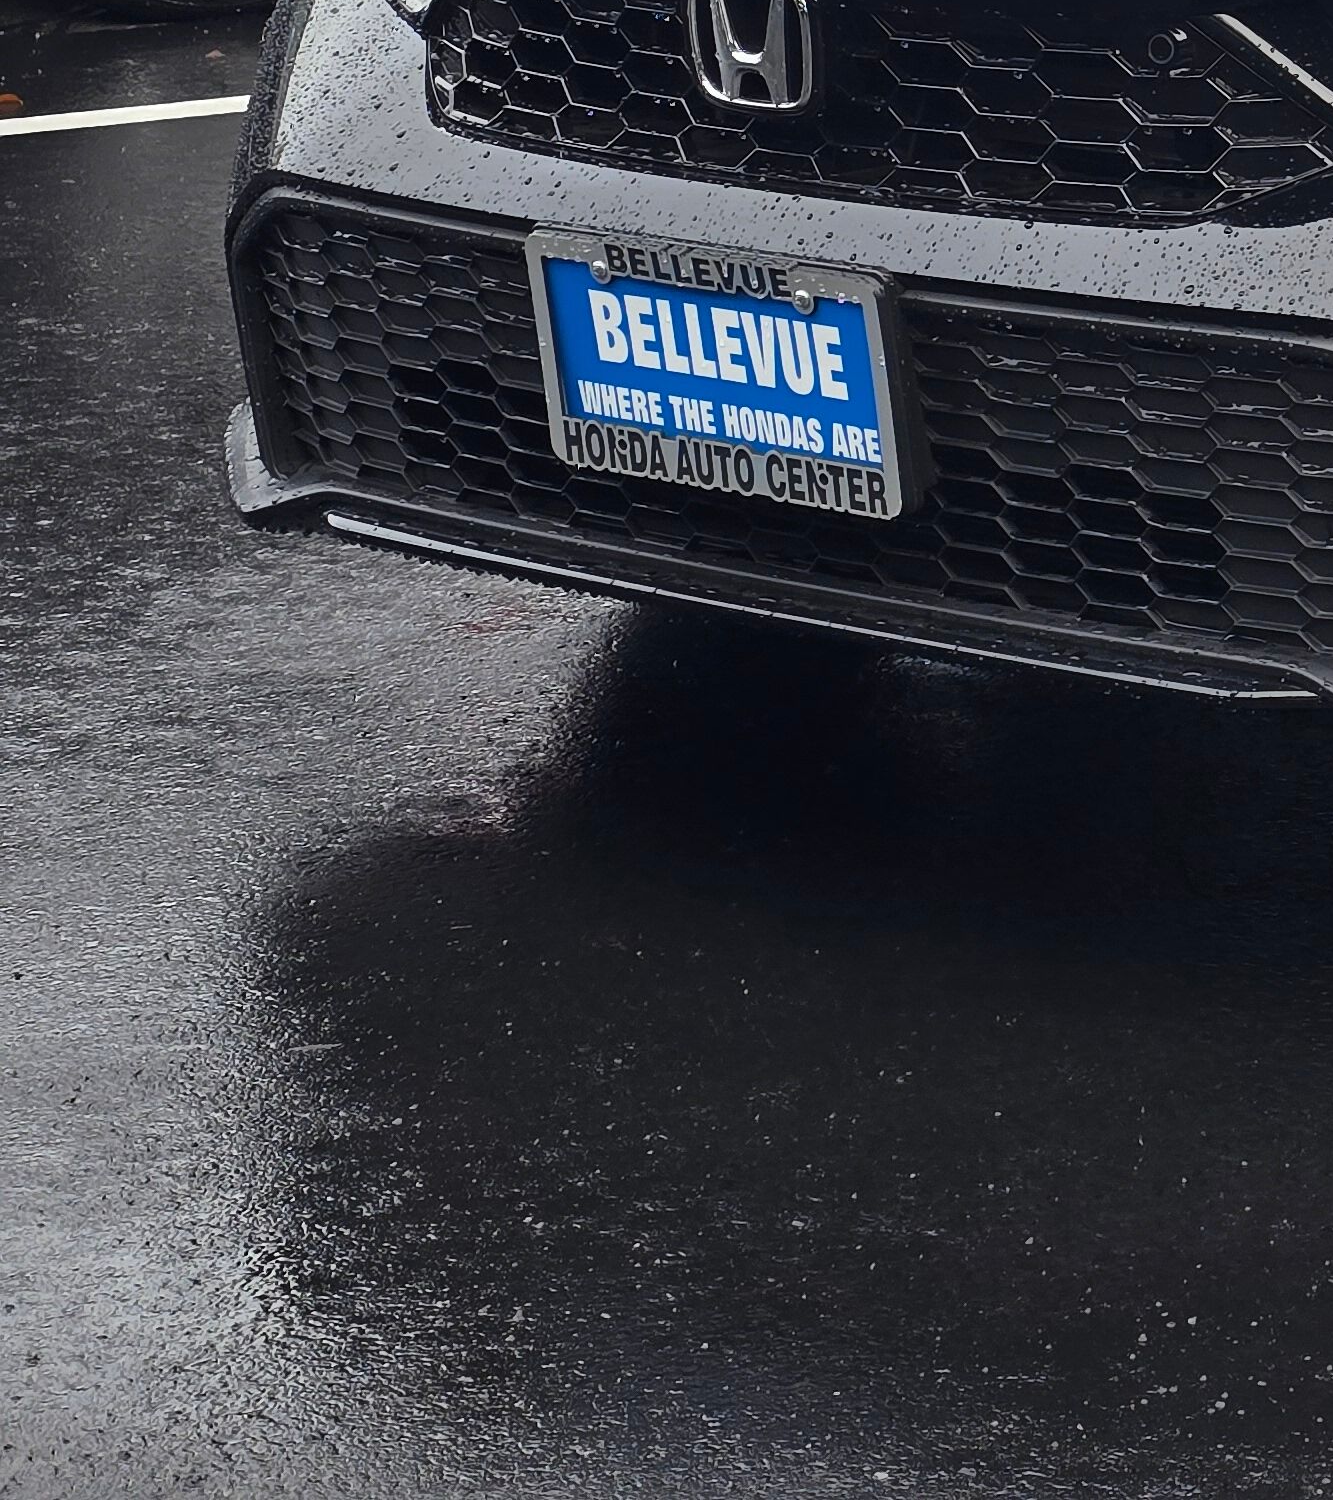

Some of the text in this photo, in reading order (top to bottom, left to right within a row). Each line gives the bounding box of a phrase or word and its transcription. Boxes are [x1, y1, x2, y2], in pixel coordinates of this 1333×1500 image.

[604, 243, 790, 298] BELLEVUE
[588, 289, 849, 401] BELLEVUE
[577, 379, 882, 463] WHERE THE HONDAS ARE
[562, 420, 889, 516] HONDA AUTO CENTER
